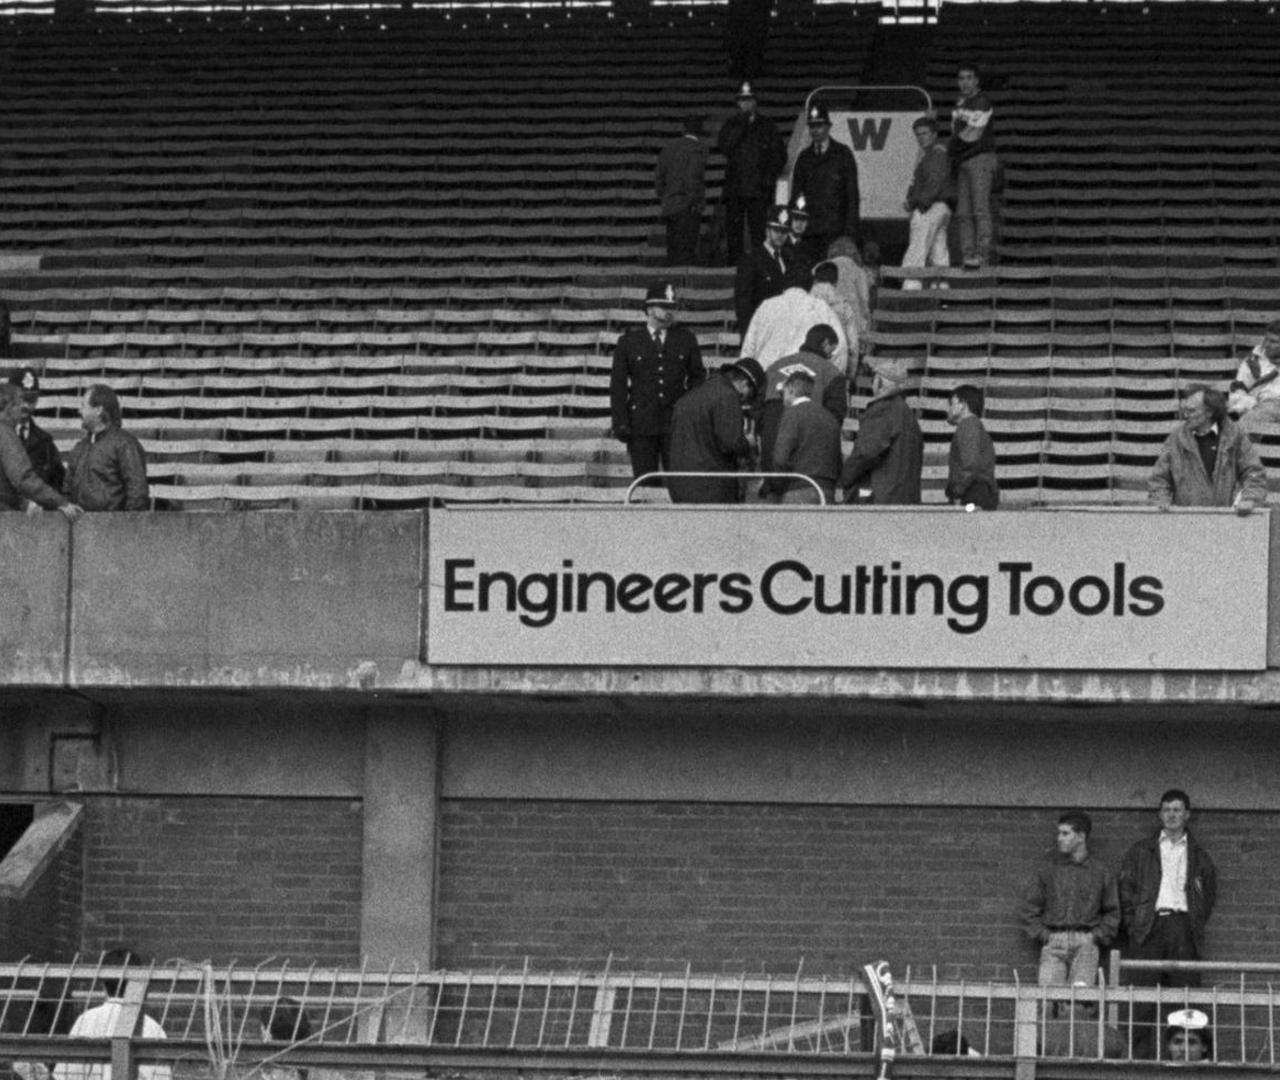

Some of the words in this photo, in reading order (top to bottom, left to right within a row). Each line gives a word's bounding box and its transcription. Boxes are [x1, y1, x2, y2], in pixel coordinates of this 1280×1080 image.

[847, 118, 892, 152] W
[444, 558, 754, 628] Engineers
[760, 559, 989, 635] Cutting
[998, 561, 1166, 617] Tools
